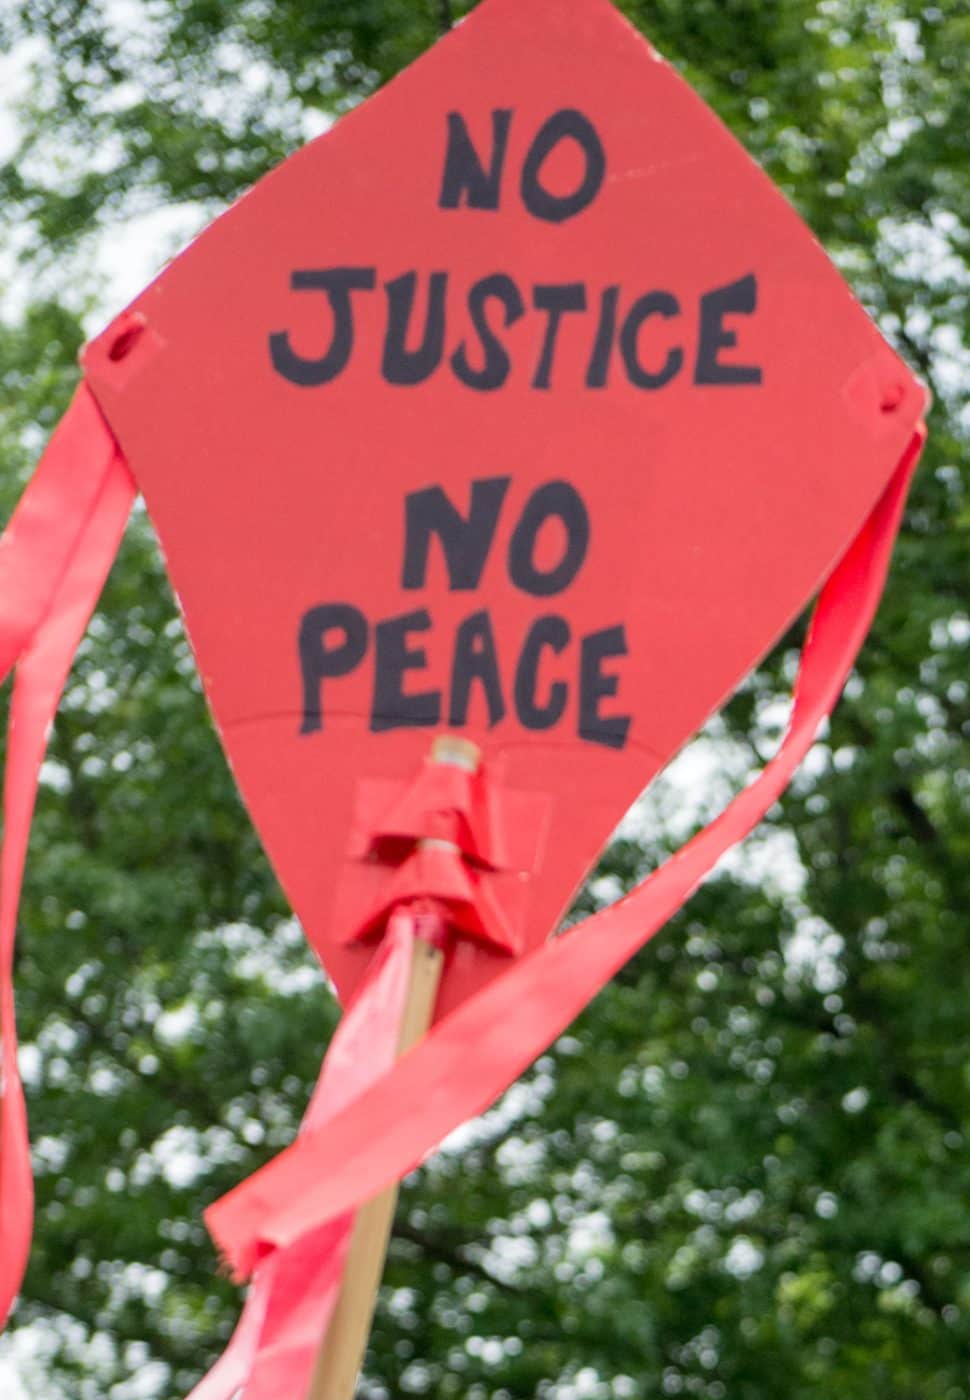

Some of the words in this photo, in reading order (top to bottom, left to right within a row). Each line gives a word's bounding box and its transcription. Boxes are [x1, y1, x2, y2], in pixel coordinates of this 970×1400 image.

[439, 108, 606, 224] NO
[269, 267, 763, 390] JUSTICE
[401, 475, 589, 596] NO
[297, 603, 632, 749] PEACE
